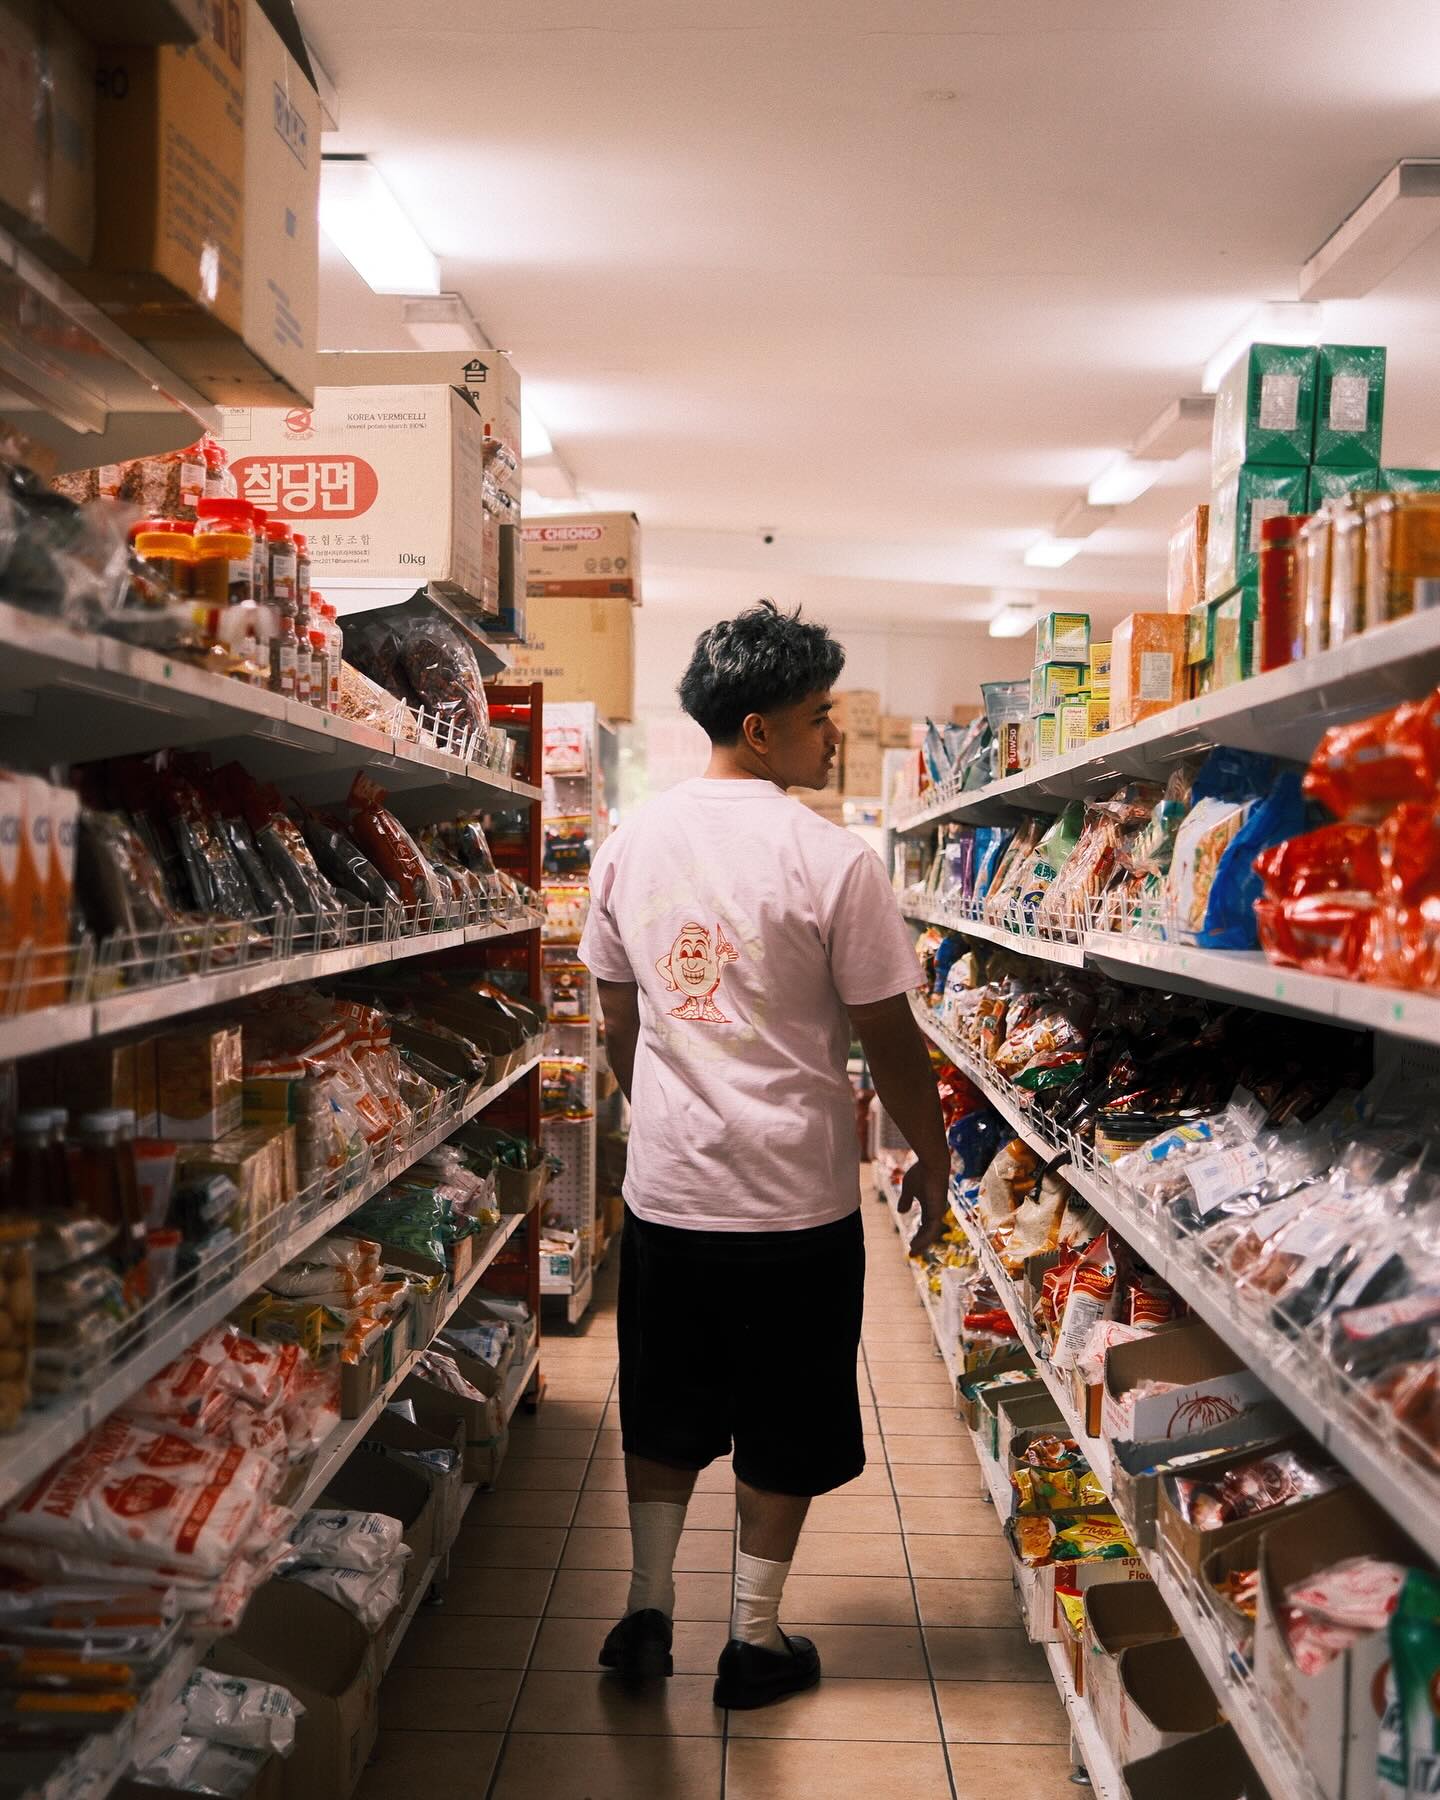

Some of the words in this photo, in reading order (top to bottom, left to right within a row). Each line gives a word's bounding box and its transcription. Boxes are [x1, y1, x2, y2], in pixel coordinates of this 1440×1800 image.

[347, 412, 375, 421] KOREA
[377, 412, 427, 421] VERMICELLI
[243, 461, 355, 513] 찰당면
[543, 527, 600, 540] CHEONG
[399, 553, 426, 566] 10kg
